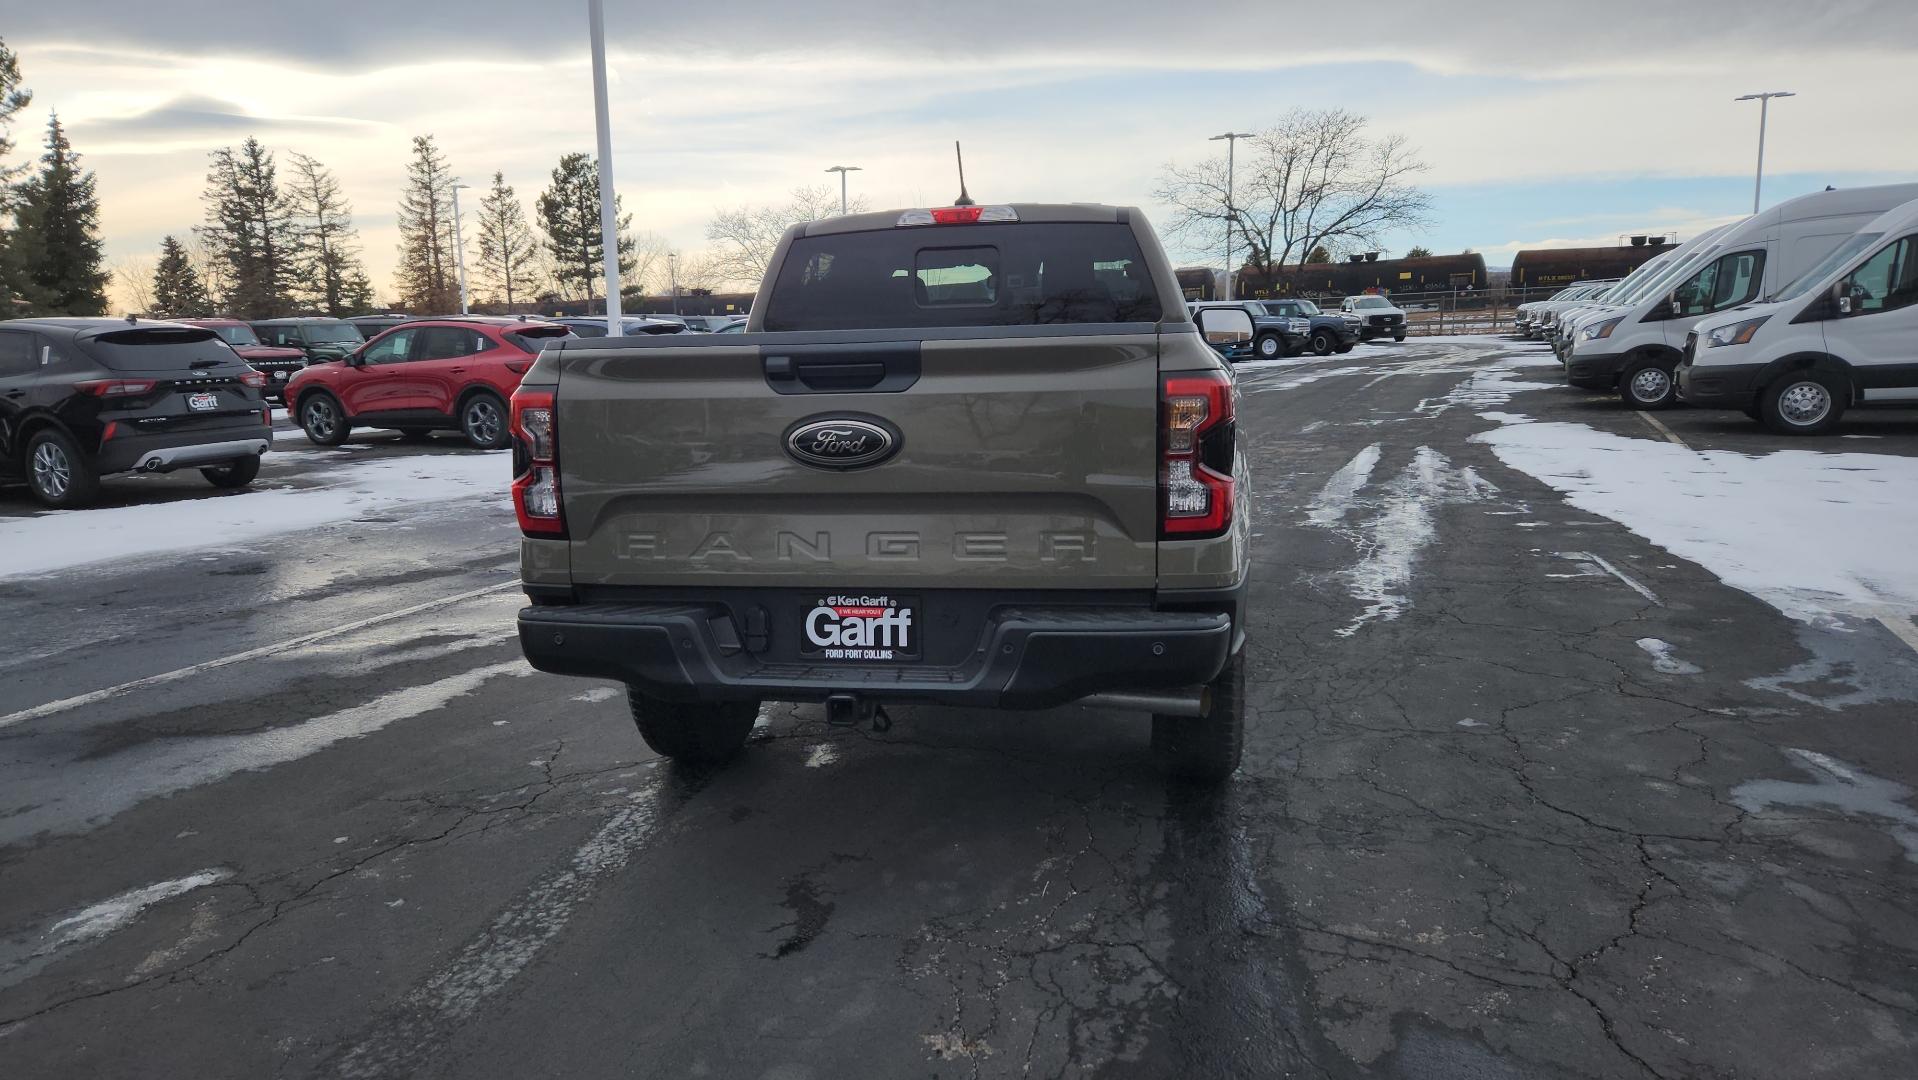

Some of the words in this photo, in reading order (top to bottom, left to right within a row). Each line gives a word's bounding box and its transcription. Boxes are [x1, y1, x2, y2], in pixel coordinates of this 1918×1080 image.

[189, 395, 218, 409] Garff
[812, 429, 867, 454] Ford
[614, 530, 1098, 562] RANGER
[837, 595, 859, 606] Ken
[860, 595, 888, 607] Garff
[805, 606, 911, 647] Garff
[825, 649, 844, 659] FORD
[845, 649, 863, 659] FORT
[863, 649, 893, 660] COLLINS
